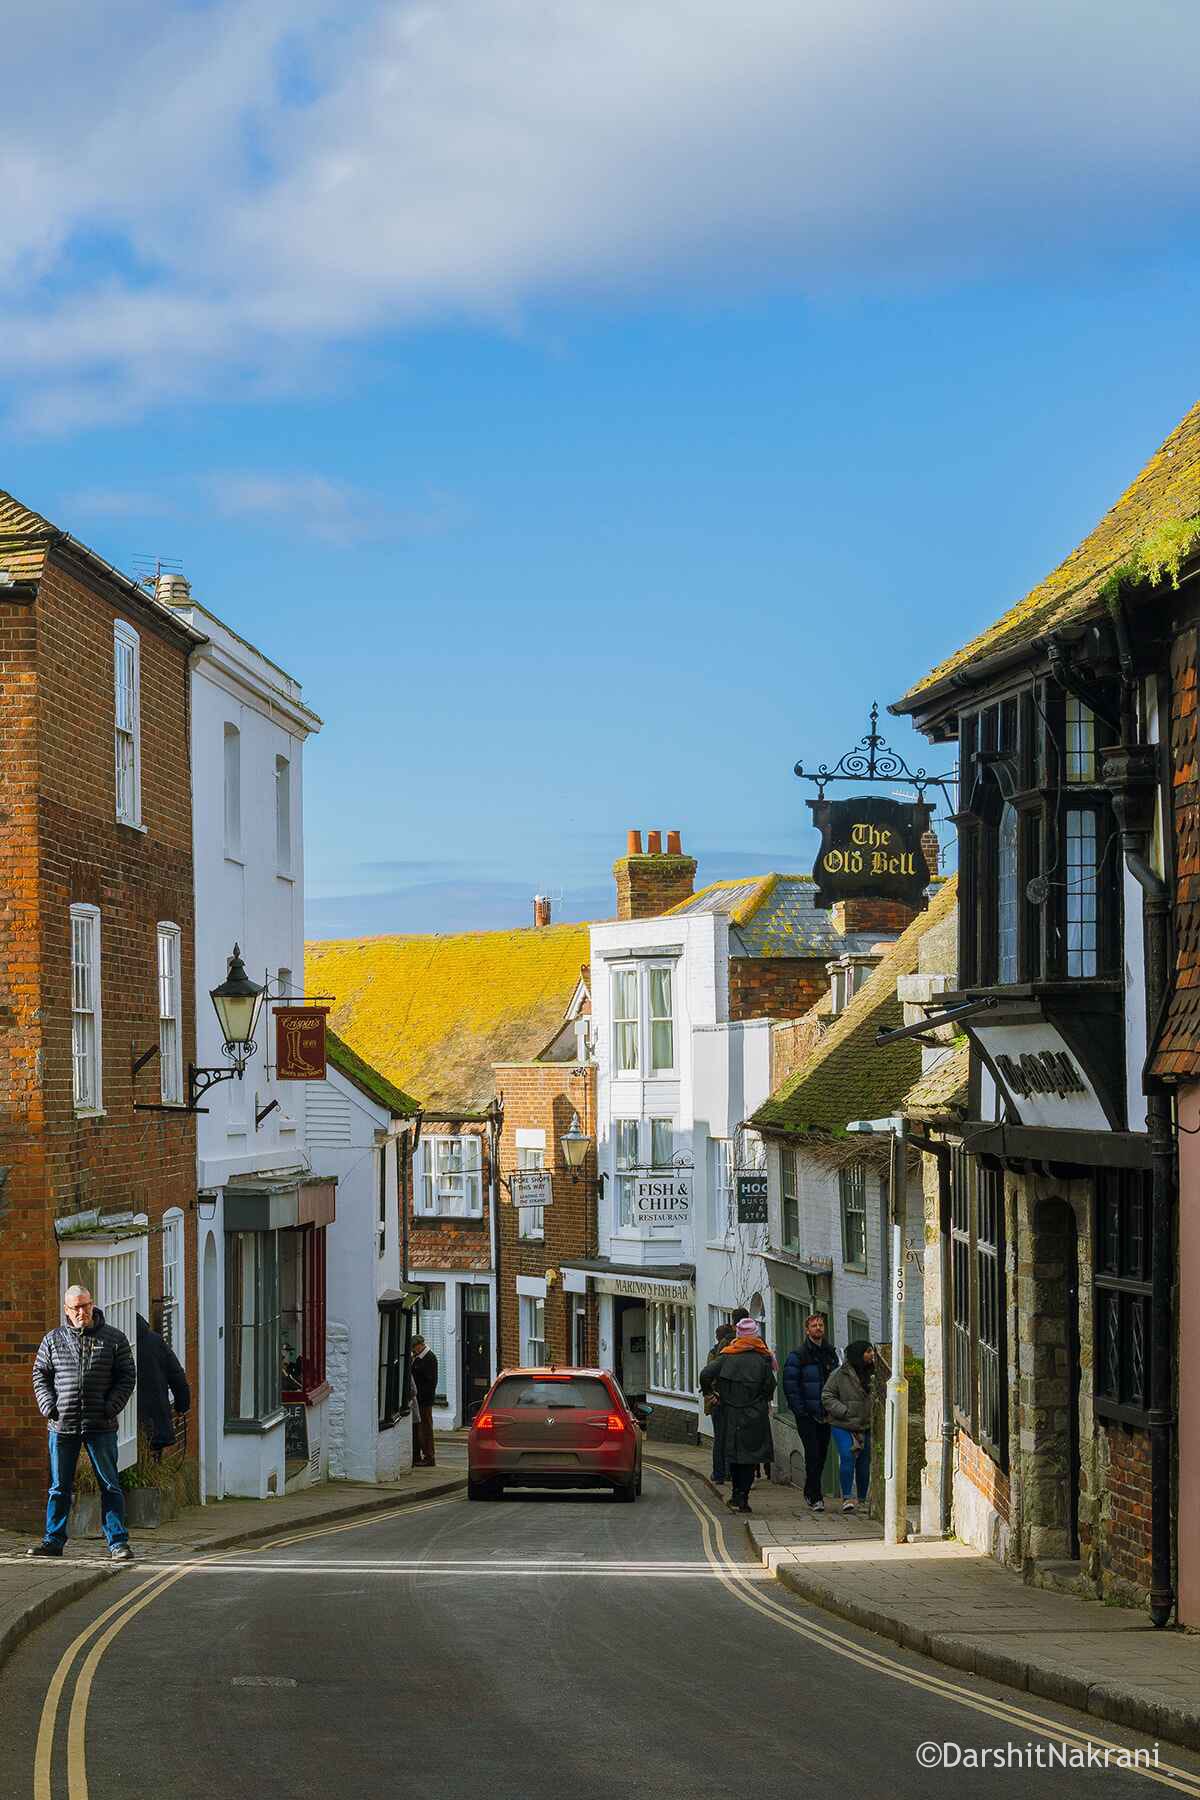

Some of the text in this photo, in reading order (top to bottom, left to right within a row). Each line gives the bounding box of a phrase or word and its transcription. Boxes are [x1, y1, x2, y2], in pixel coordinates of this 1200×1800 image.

[851, 823, 892, 850] The
[823, 849, 917, 876] Old Bell
[638, 1183, 688, 1196] FISH &
[638, 1197, 689, 1210] CHIPS
[638, 1214, 688, 1222] RESTAURANT
[653, 1283, 671, 1298] FISH
[671, 1285, 688, 1300] BAR
